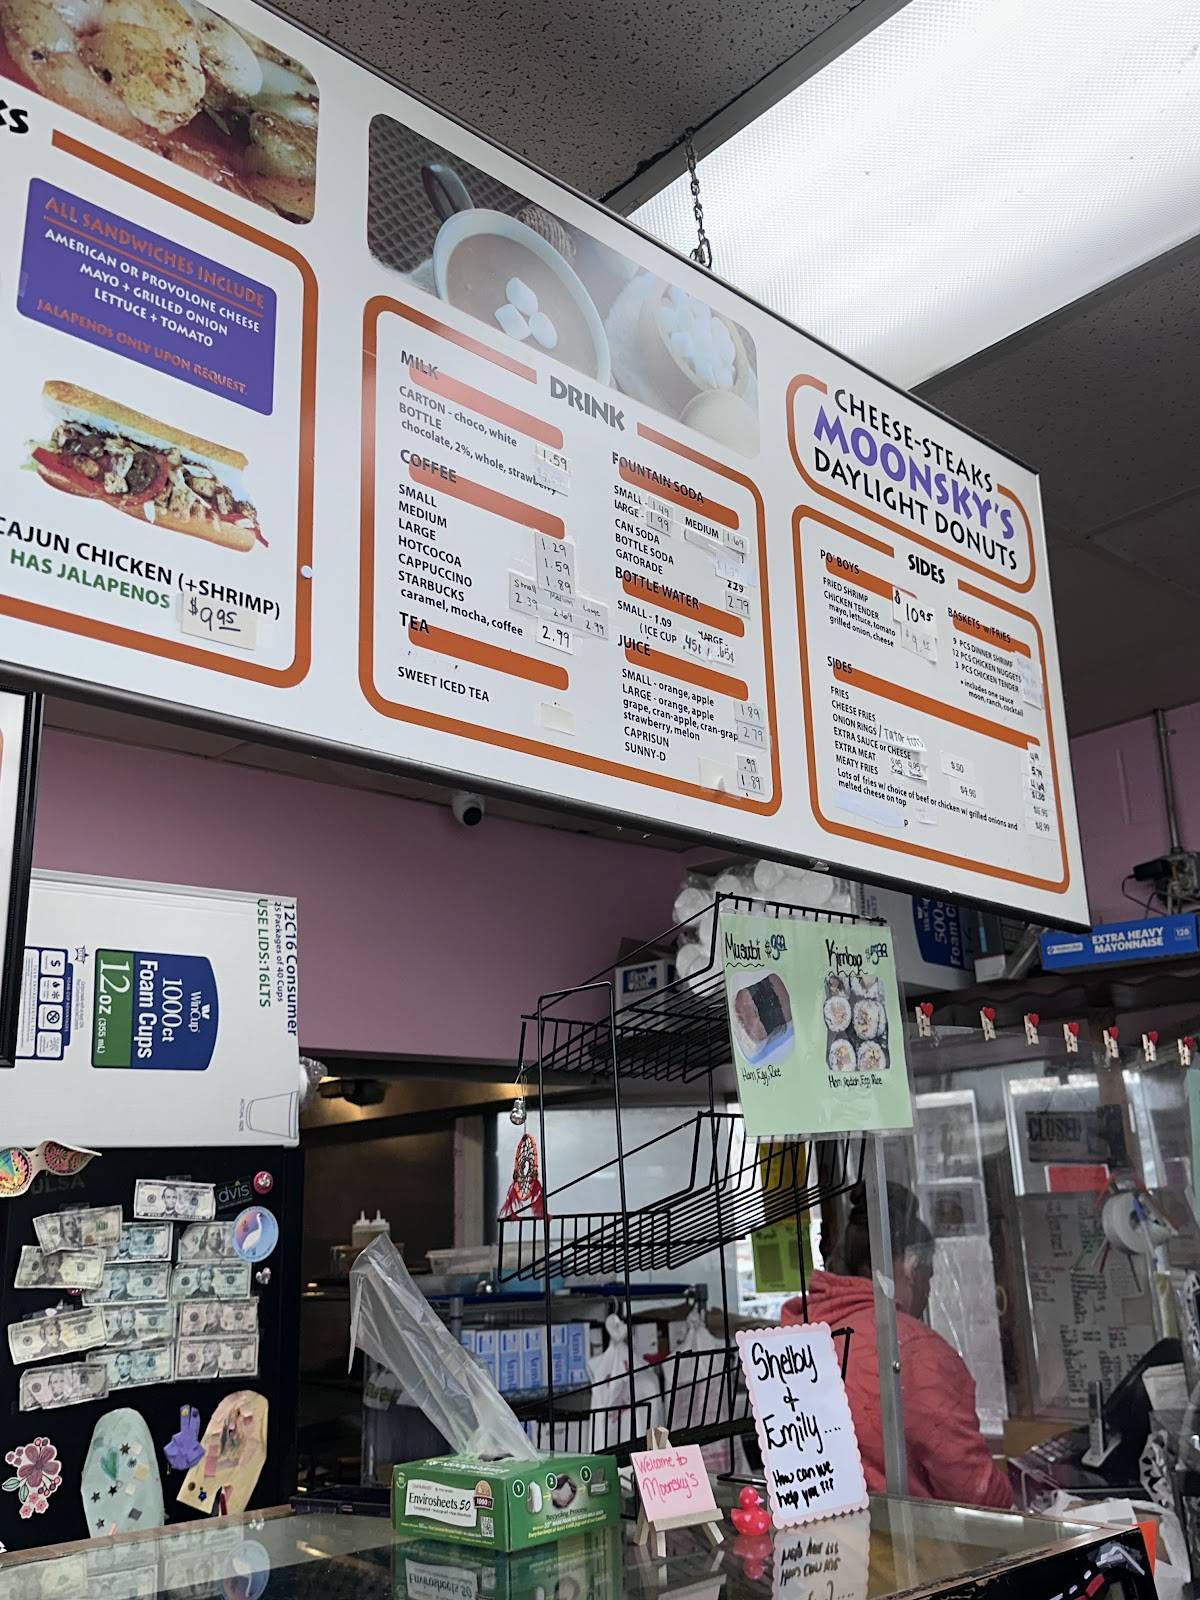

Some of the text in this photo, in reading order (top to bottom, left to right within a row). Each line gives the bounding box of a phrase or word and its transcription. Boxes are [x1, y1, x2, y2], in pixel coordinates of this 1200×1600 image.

[45, 196, 264, 308] ALL SANDWICHES INCLUDE
[45, 229, 260, 333] AMERICAN OR PROVOLONE CHEESE
[80, 263, 228, 336] MAYO GRILLED ONION
[94, 287, 213, 347] LETTUCE TOMATO
[116, 332, 152, 354] ONLY
[154, 348, 191, 371] UPON
[401, 350, 439, 380] MILK
[399, 386, 517, 447] CARTON choco, white
[400, 402, 442, 430] BOTTLE
[550, 375, 625, 432] DRINK
[401, 420, 506, 473] chocolate, 2%, whole,
[834, 389, 993, 493] CHEESE-STEAKS
[400, 449, 457, 483] COFFEE
[612, 451, 704, 503] FOUNTAIN SODA
[813, 405, 1015, 540] MOONSKY'S
[399, 484, 437, 508] SMALL
[614, 485, 642, 505] SMALL
[614, 499, 639, 518] LARGE
[814, 446, 1017, 571] DAYLIGHT DONUTS
[399, 500, 447, 528] MEDIUM
[399, 517, 436, 541] LARGE
[685, 516, 719, 539] MEDIUM
[615, 518, 660, 545] CAN SODA
[398, 535, 462, 568] HOTCOCOA
[615, 533, 674, 565] BOTTLE SODA
[616, 548, 663, 575] GATORADE
[10, 548, 170, 609] HAS JALAPENOS
[398, 553, 473, 587] CAPPUCCINO
[836, 556, 860, 575] BOYS
[908, 554, 946, 584] SIDES
[76, 542, 172, 585] CHICKEN
[178, 573, 280, 621] (+SHRIMP)
[398, 570, 465, 602] STARBUCKS
[615, 566, 699, 610] BOTTLE WATER
[823, 577, 869, 602] FRIED SHRIMP
[401, 588, 523, 636] caramel, mocha, coffee
[617, 600, 647, 619] SMALL
[824, 590, 879, 620] CHICKEN TENDER
[947, 608, 980, 629] BASKETS
[399, 612, 430, 634] TEA
[829, 604, 896, 637] mayo, tomato
[829, 615, 851, 630] grilled
[873, 633, 894, 648] cheese
[542, 625, 570, 648] 2.99
[618, 634, 650, 656] JUICE
[661, 631, 677, 644] CUP
[960, 639, 992, 659] PCS DINNER
[827, 656, 853, 674] SIDES
[960, 651, 972, 663] PCS
[972, 657, 996, 672] CHICKEN
[398, 666, 490, 703] SWEET ICED TEA
[622, 668, 714, 707] SMALL orange, apple
[962, 663, 1019, 692] PCS CHICKEN TENDER
[964, 680, 987, 695] includes
[622, 683, 714, 722] LARGE orange, apple
[831, 686, 849, 700] FRIES
[623, 699, 699, 729] grape, cran-apple,
[623, 711, 700, 741] strawberry, melon
[831, 700, 876, 723] CHEESE FRIES
[832, 713, 877, 736] ONION RINGS
[624, 726, 669, 748] CAPRISUN
[624, 741, 666, 762] SUNNY-D
[833, 727, 911, 761] EXTRA SAUCE CHEESE
[834, 740, 876, 762] EXTRA MEAT
[836, 754, 859, 770] MEATY
[860, 762, 879, 775] FRIES
[837, 768, 987, 823] Lots fries choice beef chicken grilled
[838, 779, 885, 800] melted cheese
[258, 899, 268, 925] USE
[274, 914, 284, 978] Packages 40
[725, 931, 762, 961] Musubi
[1092, 927, 1164, 945] EXTRA HEAVY
[1094, 937, 1164, 955] MAYONNAISE
[284, 904, 298, 1036] 12C16 Consumer
[98, 959, 131, 1015] 12 oz
[133, 959, 158, 1058] Foam Cups
[161, 977, 184, 1042] 1000ct
[188, 991, 202, 1033] WinCup
[752, 1342, 818, 1384] Shelby
[634, 1451, 688, 1474] Welcome to
[772, 1460, 834, 1488] How can we
[409, 1491, 458, 1511] Envirosheets
[459, 1499, 472, 1512] 50
[642, 1471, 700, 1503] Moonsky's
[775, 1490, 799, 1510] help
